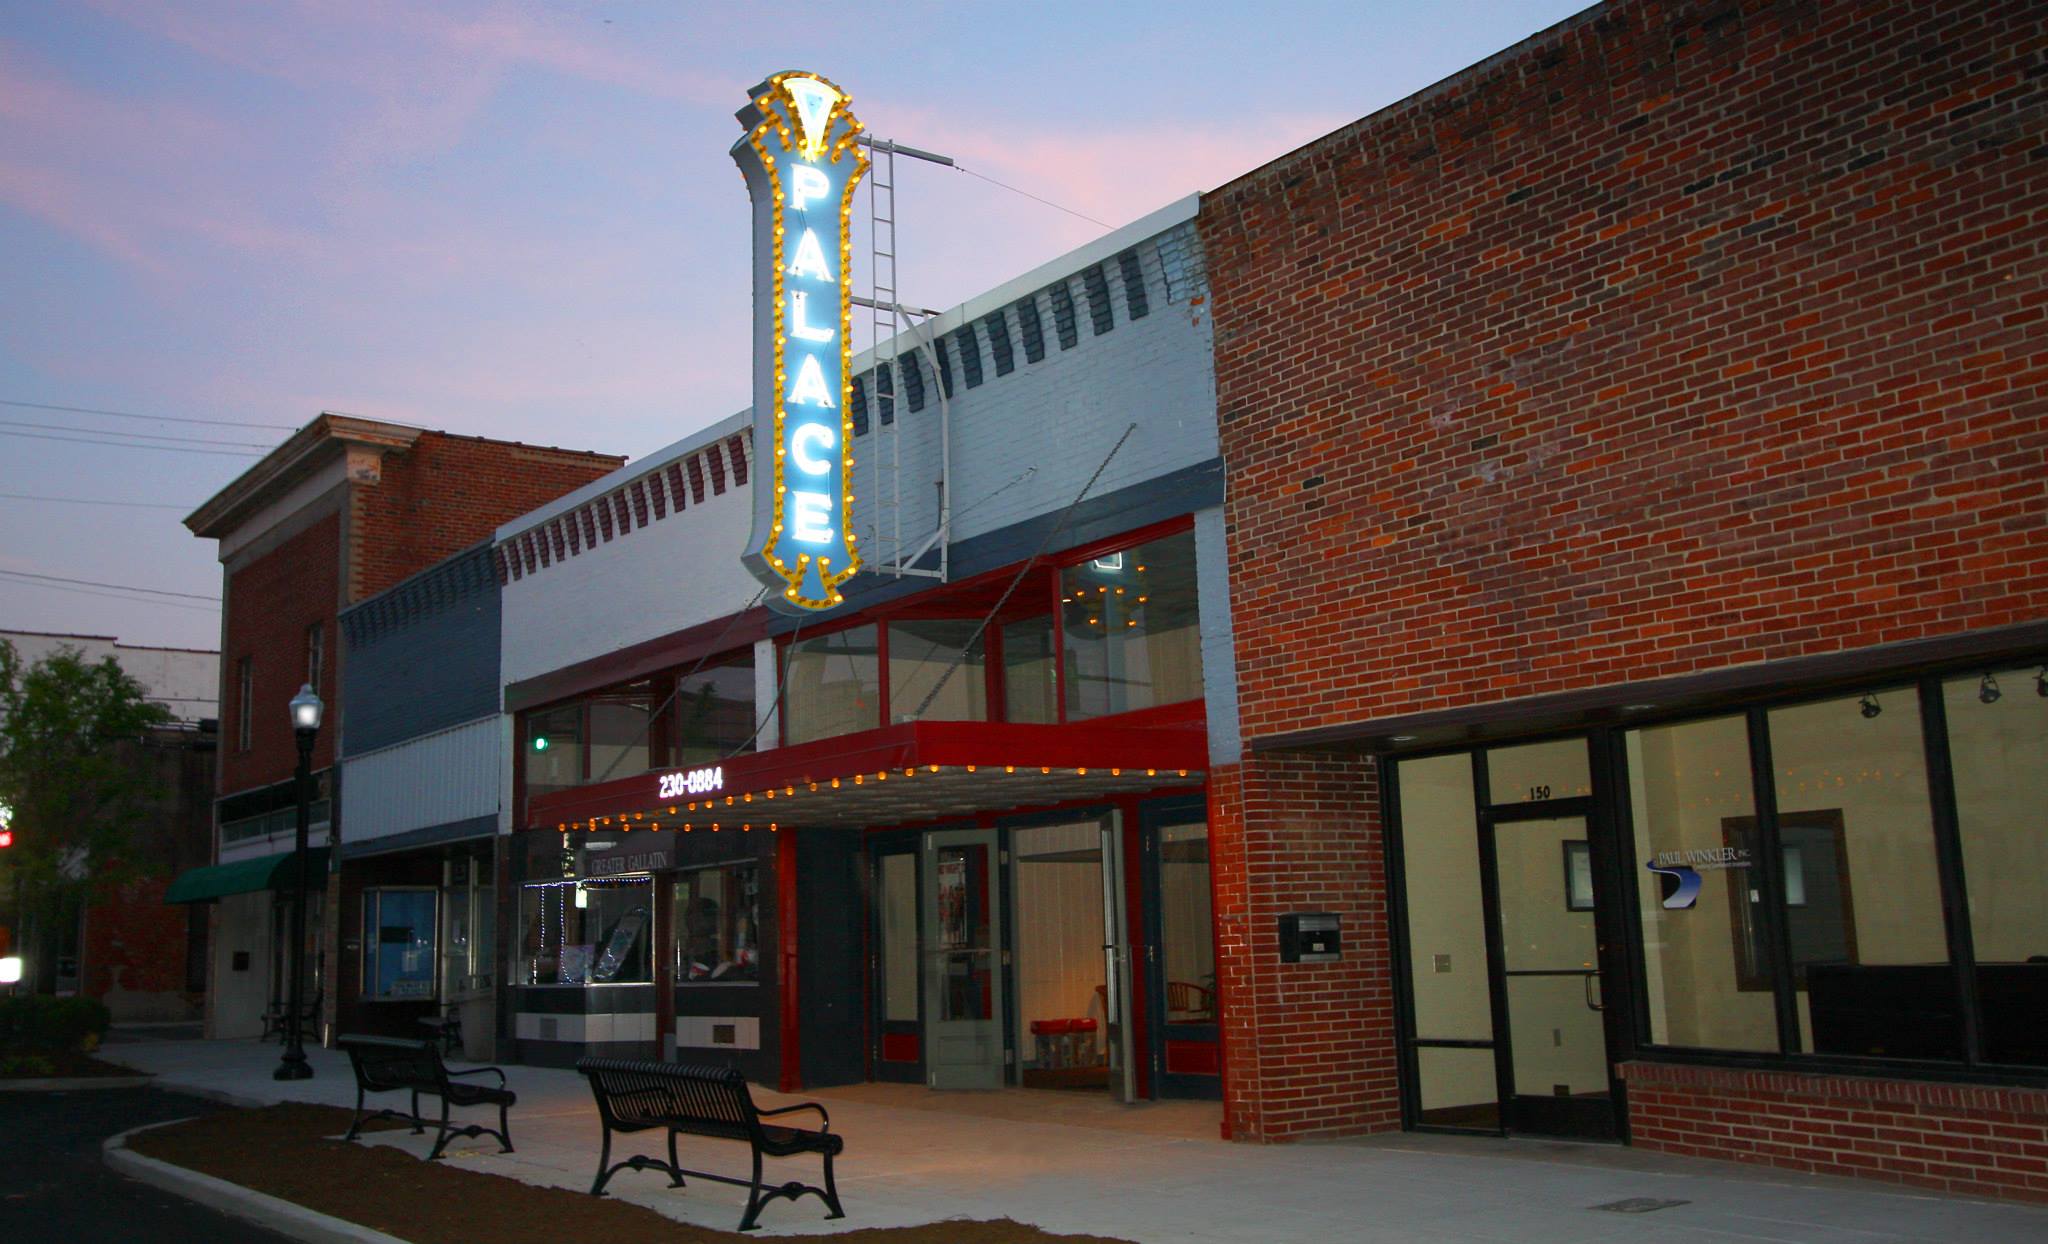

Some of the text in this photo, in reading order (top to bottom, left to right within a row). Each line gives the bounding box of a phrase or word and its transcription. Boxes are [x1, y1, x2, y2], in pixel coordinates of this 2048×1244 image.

[789, 162, 836, 545] PALACE
[659, 766, 722, 799] 230-0884
[1530, 784, 1551, 800] 150
[591, 856, 625, 873] GREATER
[1658, 850, 1681, 865] PAUL
[1686, 847, 1737, 863] WINKLER
